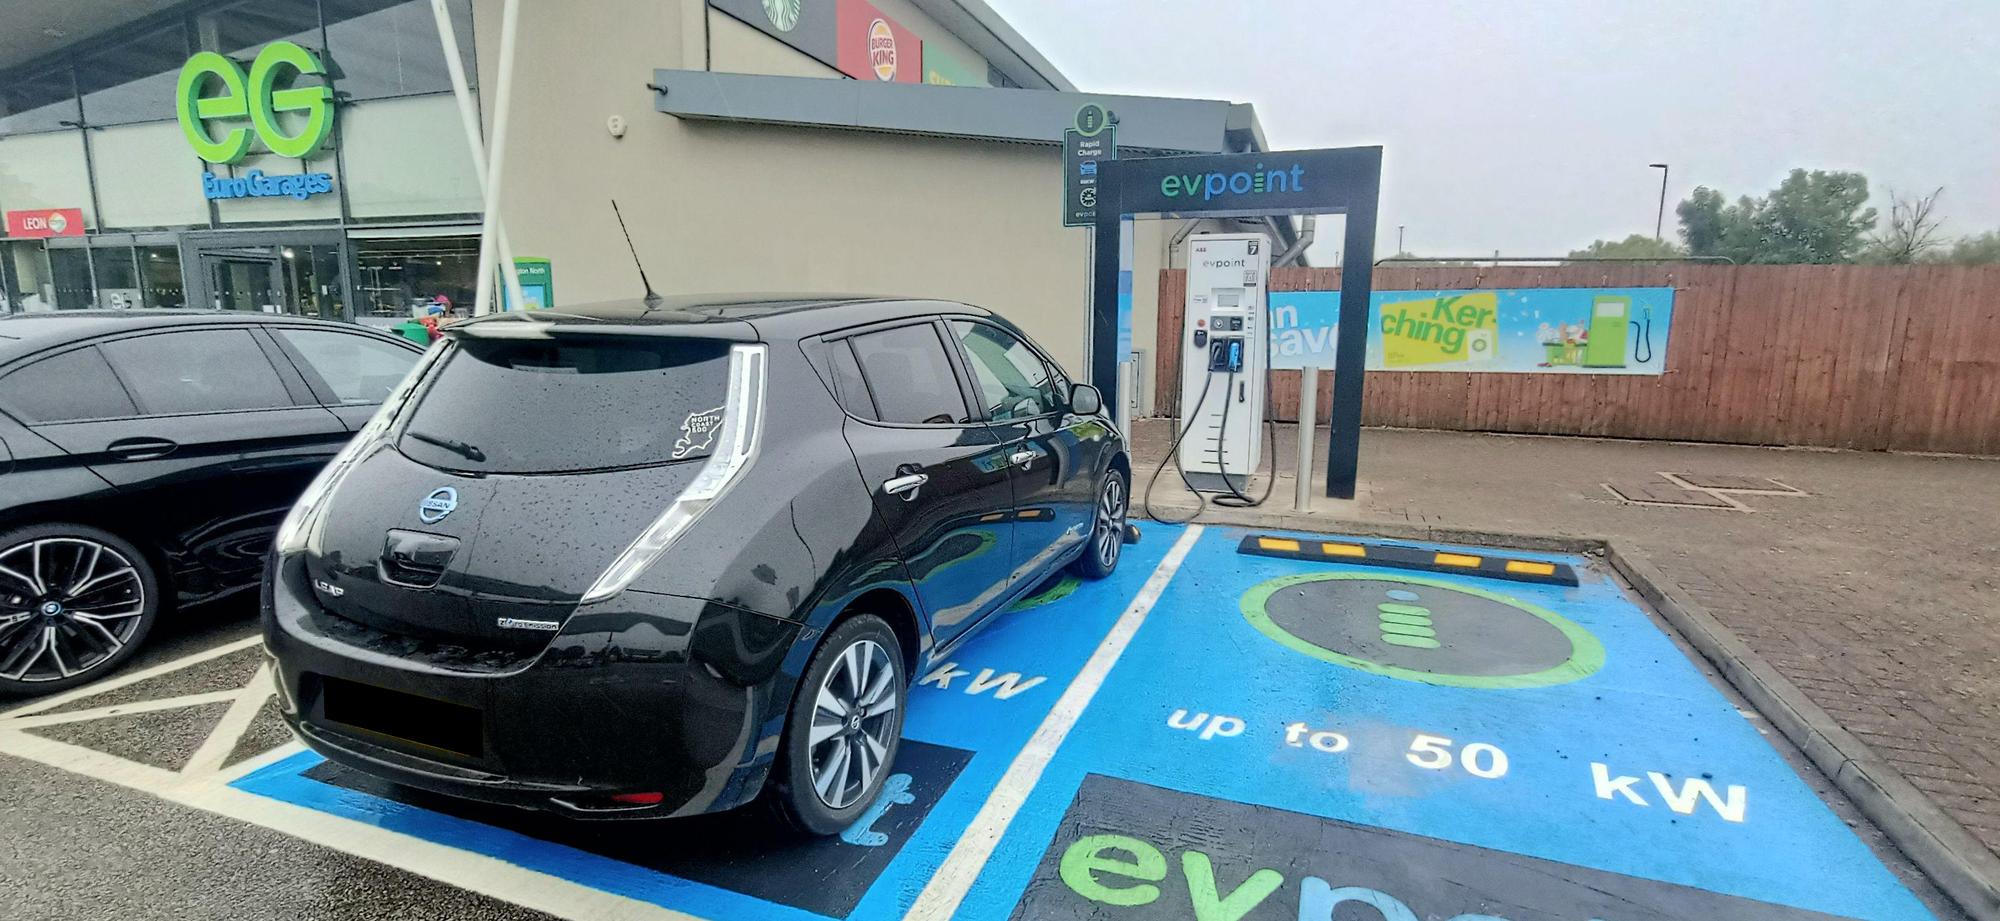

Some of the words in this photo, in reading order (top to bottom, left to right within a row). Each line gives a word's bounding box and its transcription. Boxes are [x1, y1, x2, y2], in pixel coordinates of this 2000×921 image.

[871, 38, 893, 50] BURGER
[873, 50, 894, 66] KING
[1080, 141, 1100, 149] Rapid
[1077, 149, 1102, 157] Charge
[1160, 163, 1305, 200] evpoint
[23, 217, 48, 230] LEON
[1203, 257, 1245, 268] evpoint
[1381, 309, 1467, 354] ching
[918, 662, 1047, 699] kW
[1166, 707, 1246, 742] up
[1284, 722, 1349, 753] to
[1405, 734, 1509, 779] 50
[1590, 762, 1747, 823] kW
